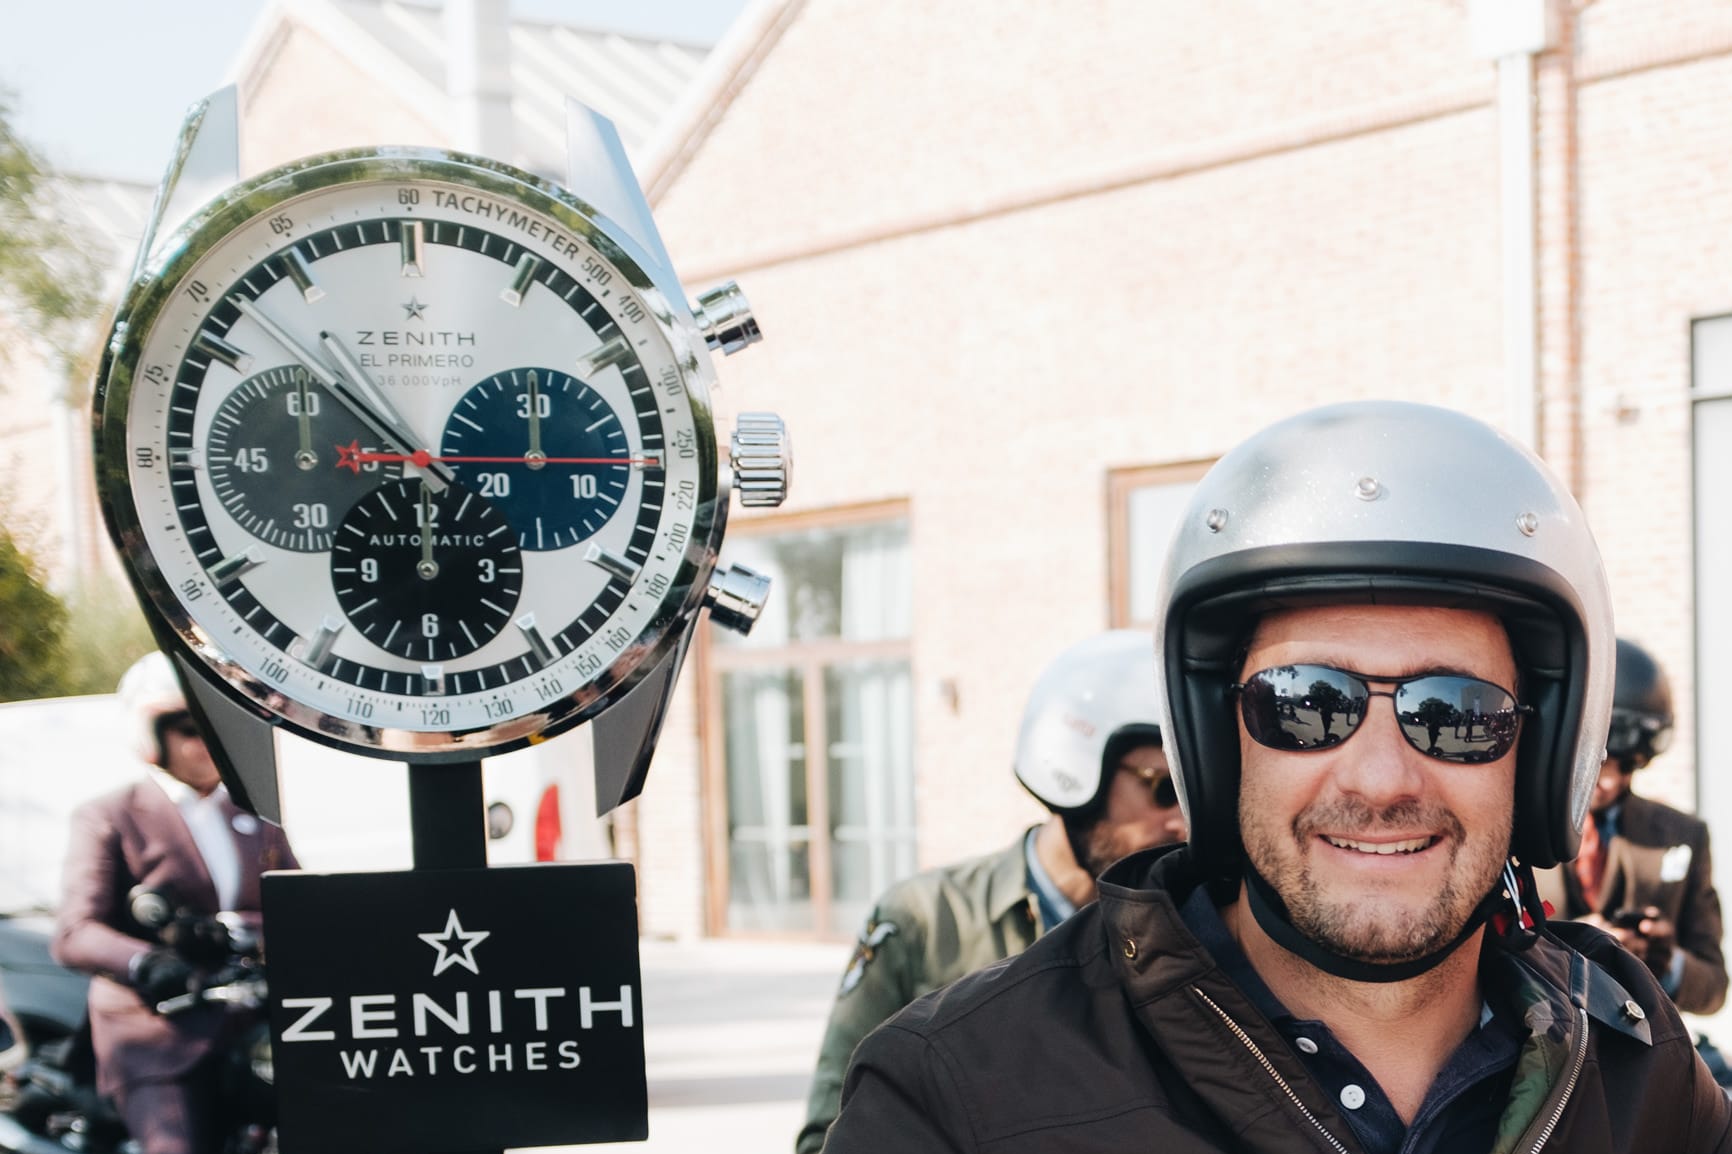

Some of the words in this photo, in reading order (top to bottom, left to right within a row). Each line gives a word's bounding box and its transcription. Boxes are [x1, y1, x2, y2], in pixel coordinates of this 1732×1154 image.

[397, 188, 420, 206] 60
[270, 214, 293, 235] 65
[432, 189, 580, 261] TACHYMETER
[580, 256, 613, 287] 500
[184, 280, 208, 303] 70
[617, 294, 646, 325] 400
[356, 330, 476, 346] ZENITH
[360, 353, 383, 367] EL
[387, 353, 475, 368] PRIMERO
[143, 364, 164, 386] 75
[660, 365, 683, 397] 300
[286, 391, 321, 417] 60
[516, 393, 551, 418] 30
[679, 428, 695, 459] 250
[136, 447, 154, 469] 80
[234, 447, 269, 473] 45
[476, 472, 511, 498] 20
[569, 473, 597, 499] 10
[677, 480, 695, 511] 220
[292, 503, 329, 528] 30
[412, 503, 440, 528] 12
[667, 522, 689, 553] 200
[360, 558, 379, 583] 9
[477, 558, 496, 583] 3
[179, 578, 200, 602] 90
[645, 573, 670, 600] 180
[421, 613, 440, 638] 6
[605, 626, 632, 654] 160
[258, 656, 290, 685] 100
[573, 652, 603, 678] 150
[534, 678, 564, 701] 140
[345, 698, 375, 720] 110
[421, 708, 451, 727] 120
[483, 698, 515, 720] 130
[281, 984, 634, 1042] ZENITH
[339, 1040, 582, 1079] WATCHES
